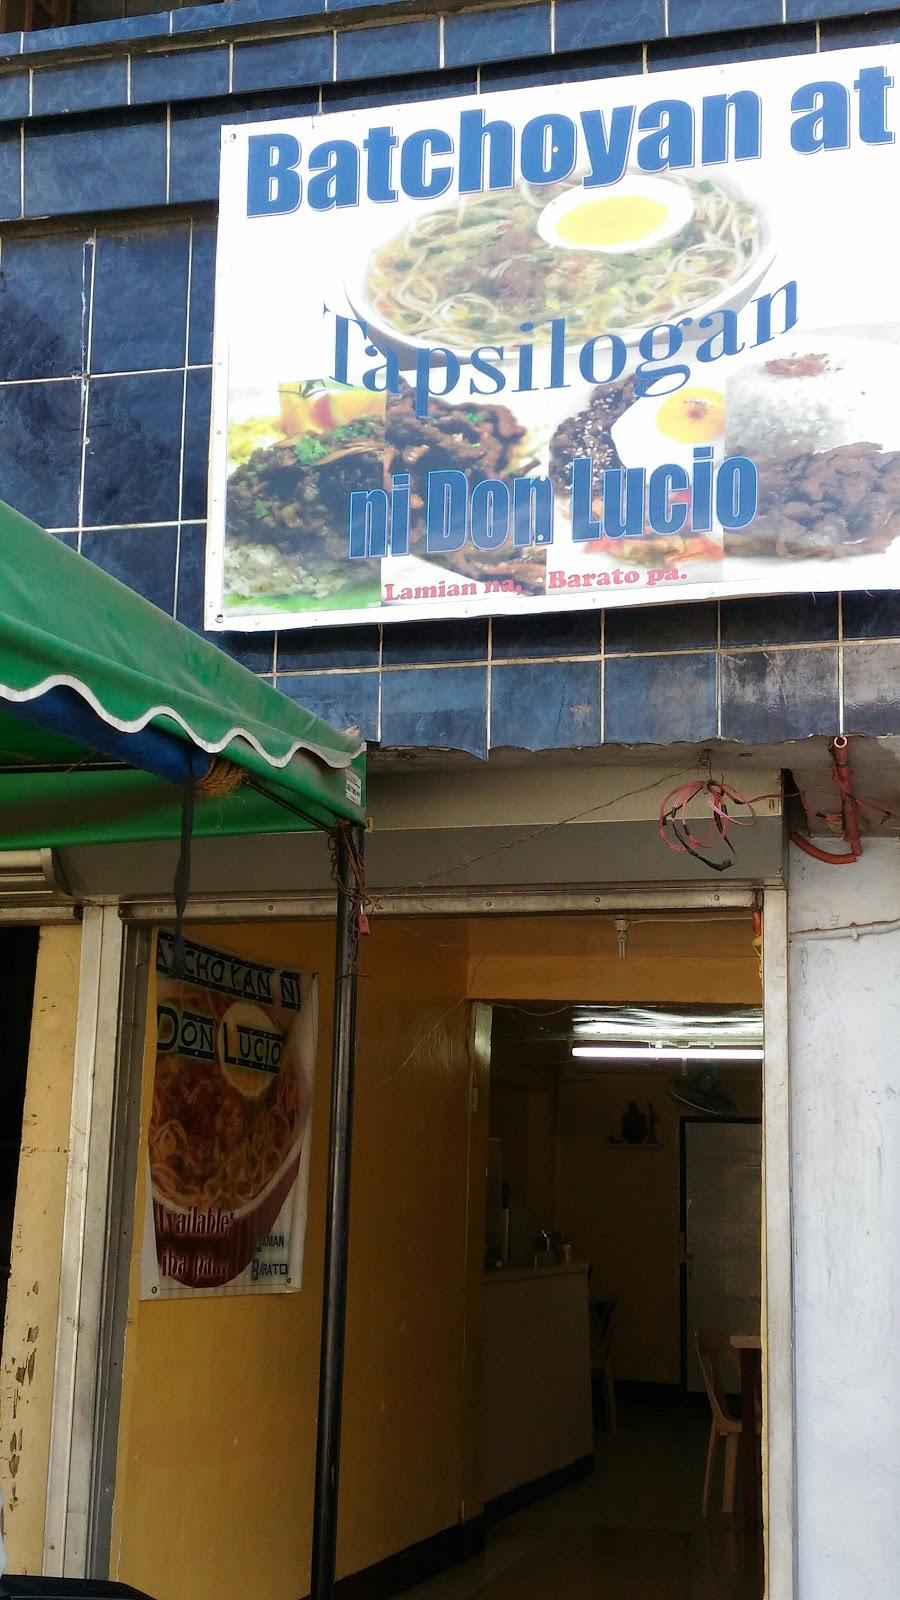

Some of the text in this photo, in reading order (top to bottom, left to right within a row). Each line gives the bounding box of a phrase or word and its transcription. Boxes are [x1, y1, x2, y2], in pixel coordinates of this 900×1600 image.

[246, 64, 896, 219] Batchoyan at
[323, 279, 799, 418] Tapsilogan
[348, 446, 759, 560] ni Don Lucio
[384, 581, 477, 602] Lamian
[548, 569, 640, 589] Barato
[646, 567, 688, 587] pa.
[280, 975, 301, 1004] NI
